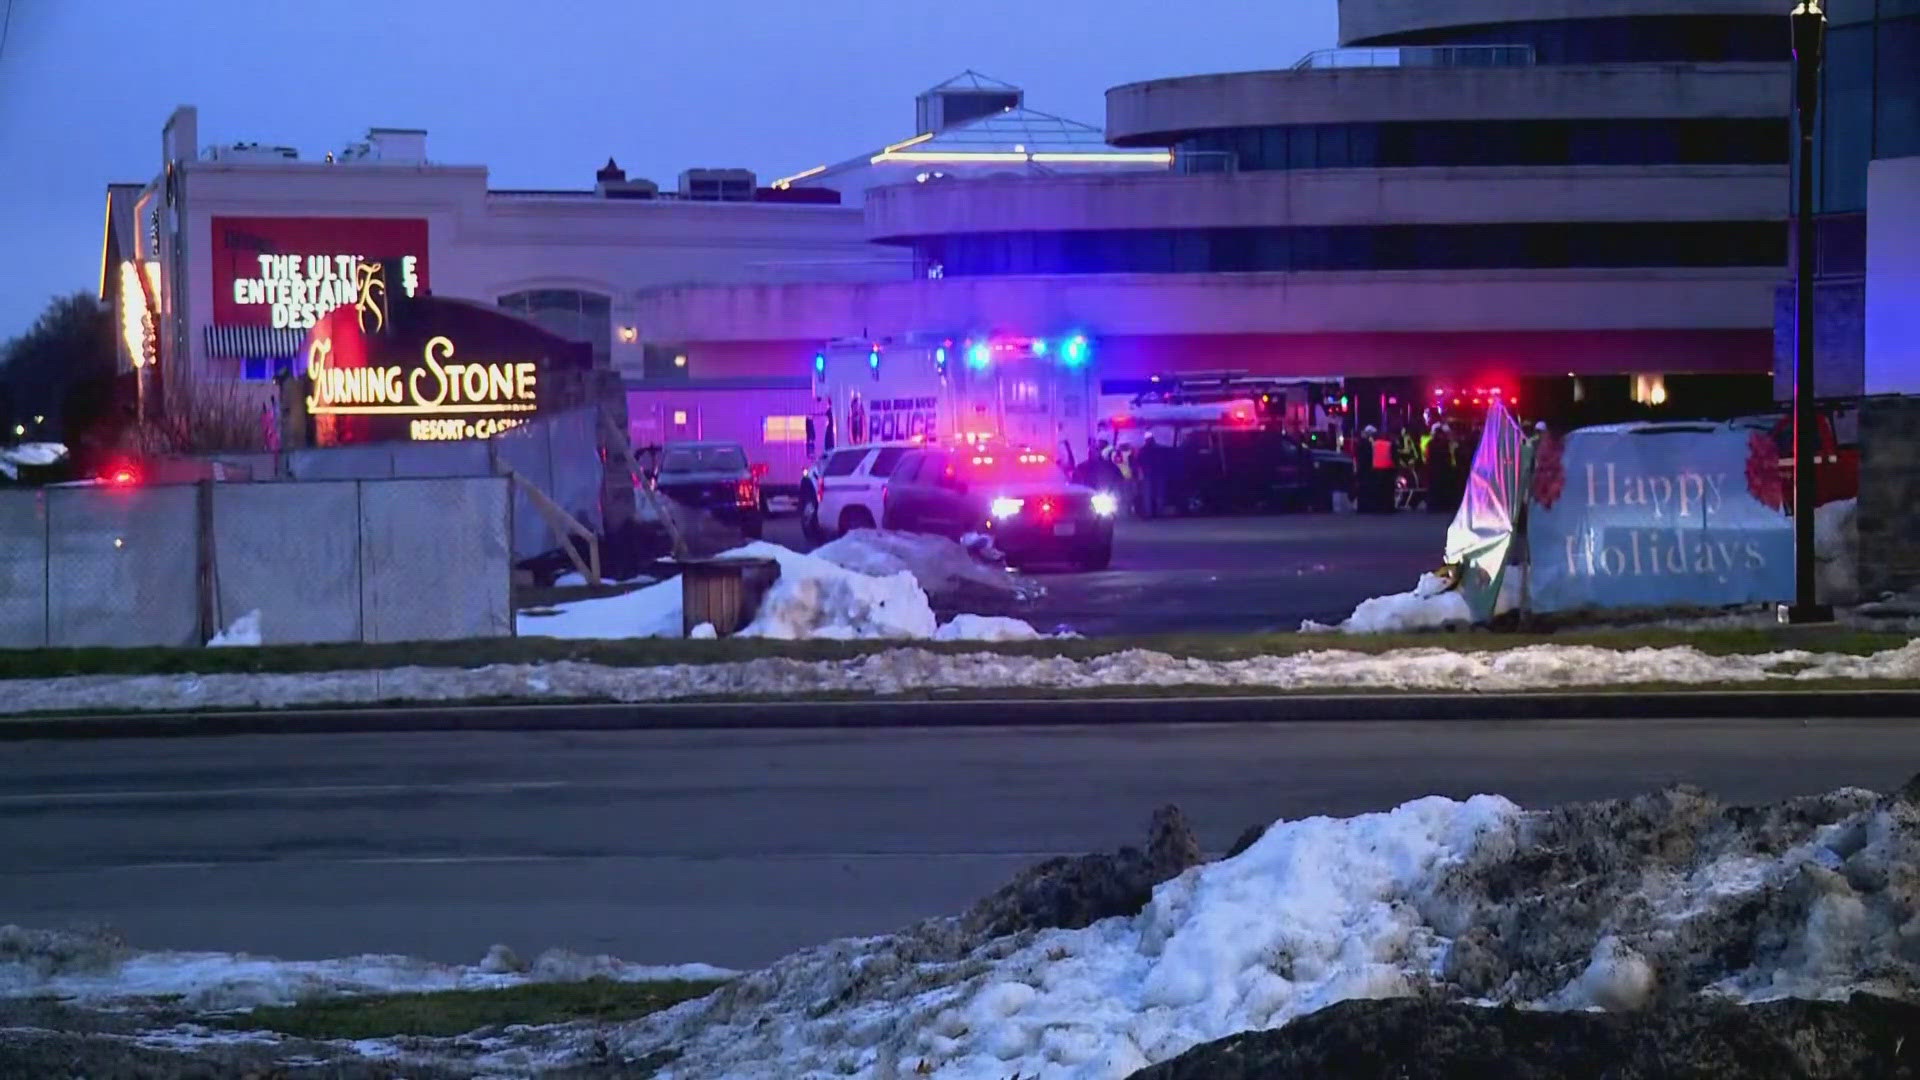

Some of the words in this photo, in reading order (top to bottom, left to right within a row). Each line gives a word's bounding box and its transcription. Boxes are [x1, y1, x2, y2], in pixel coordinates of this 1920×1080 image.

[257, 254, 302, 281] THE
[307, 254, 417, 282] ULTIE
[234, 278, 418, 305] ENTERTAINT
[409, 336, 537, 407] STONE
[410, 419, 466, 440] RESORT
[869, 412, 937, 443] POLICE
[1585, 462, 1727, 519] Happy
[1566, 527, 1766, 584] Holidays
